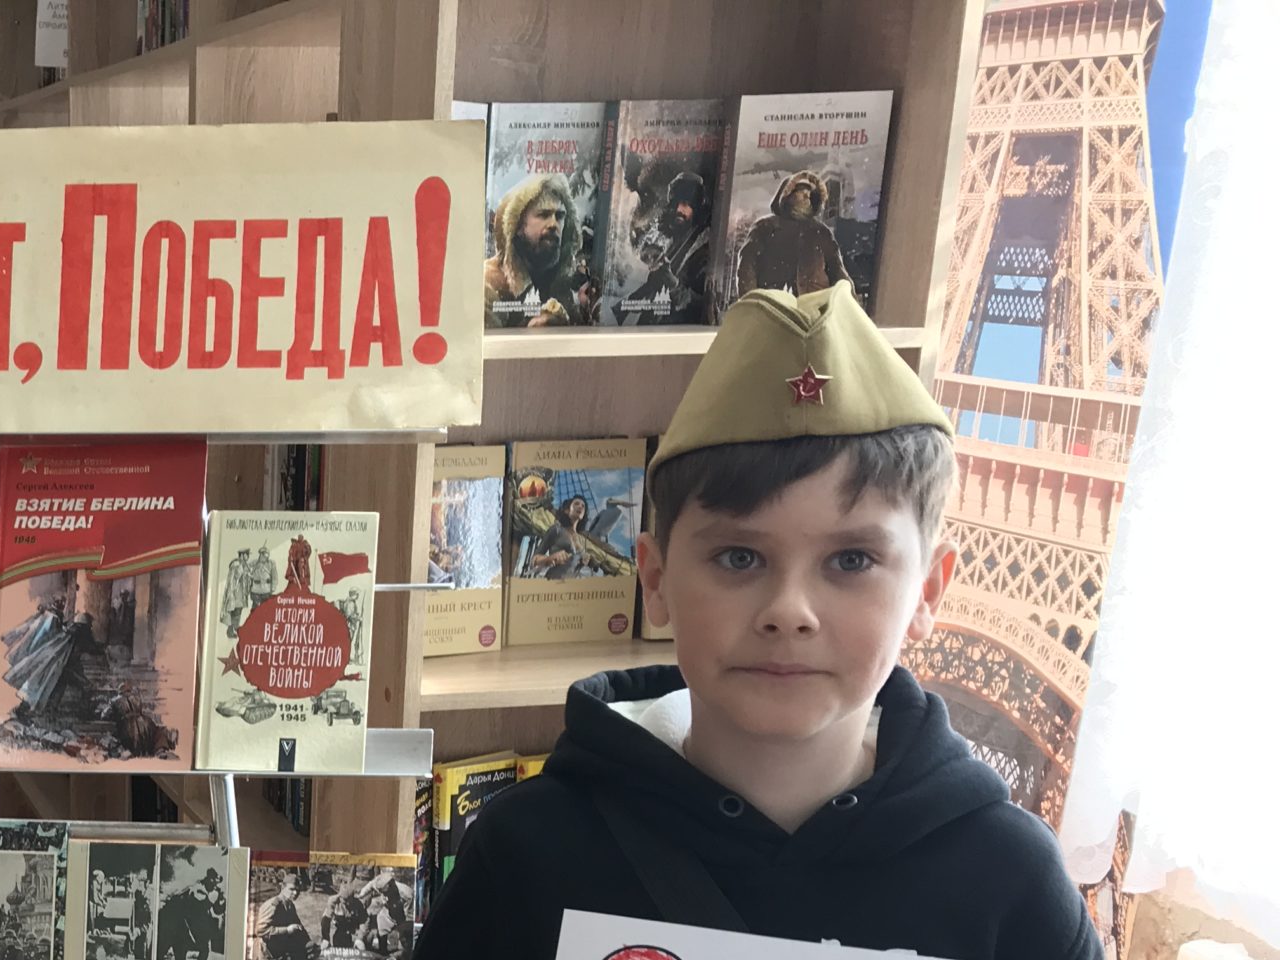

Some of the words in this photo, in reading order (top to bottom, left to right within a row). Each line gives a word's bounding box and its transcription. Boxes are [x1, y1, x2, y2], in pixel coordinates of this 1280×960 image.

[764, 113, 815, 121] СТАНИСЛАВ
[790, 131, 829, 149] ОДИН
[832, 129, 868, 148] ДЕНЬ
[527, 140, 534, 155] В
[57, 176, 451, 380] ПОБЕДА!
[15, 498, 87, 512] ВЗЯТИЕ
[90, 496, 175, 512] БЕРЛИНА
[14, 515, 94, 531] ПОБЕДА!
[516, 590, 626, 603] ПУТЕШЕСТВЕННИЦА
[275, 607, 315, 623] ИСТОРИЯ
[264, 622, 324, 645] ВЕЛИКОЙ
[243, 644, 342, 667] ОТЕЧЕСТВЕННОЙ
[269, 667, 313, 689] ВОЙНЫ
[280, 714, 307, 722] 1945
